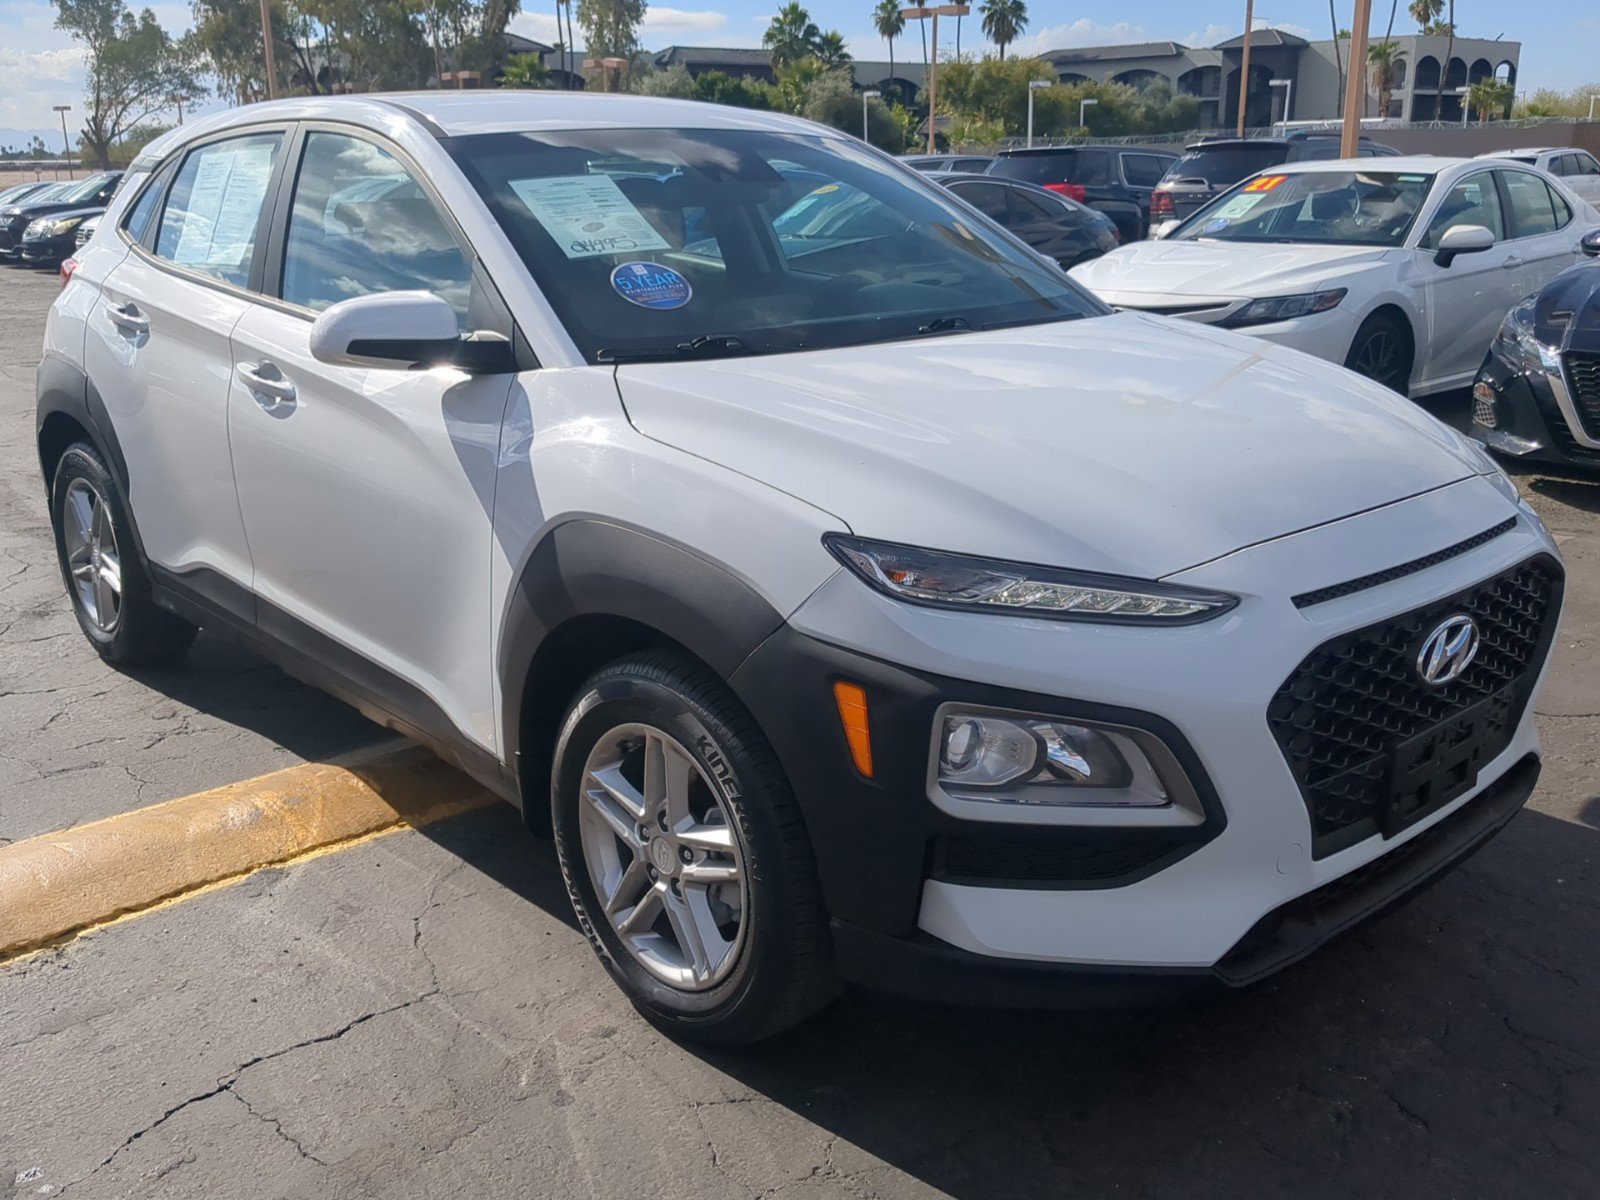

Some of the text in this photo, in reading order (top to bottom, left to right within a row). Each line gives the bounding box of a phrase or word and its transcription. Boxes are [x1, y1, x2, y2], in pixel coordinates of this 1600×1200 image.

[1244, 176, 1287, 191] 21
[616, 272, 679, 290] 5 YEAR
[625, 285, 667, 294] MAINTENANCE
